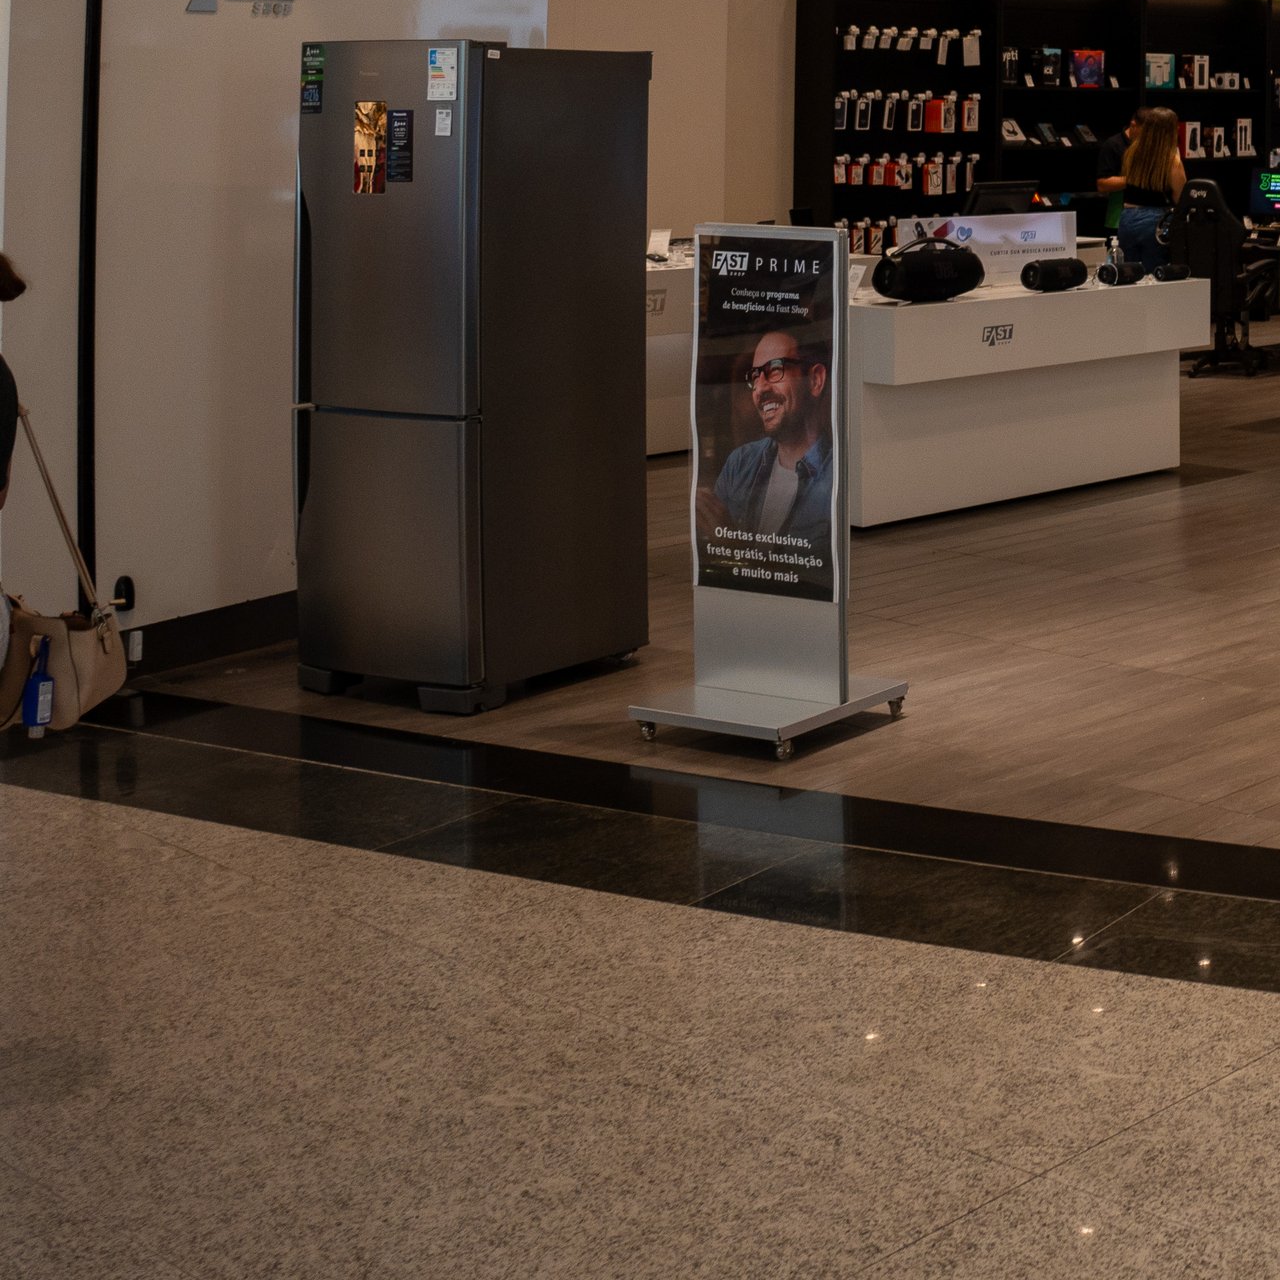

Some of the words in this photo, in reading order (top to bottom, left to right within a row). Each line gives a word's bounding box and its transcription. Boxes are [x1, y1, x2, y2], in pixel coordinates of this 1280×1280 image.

[1003, 50, 1019, 62] yeti
[713, 252, 748, 275] FAST
[755, 258, 820, 274] PRIME
[731, 288, 760, 298] Conheça
[766, 291, 800, 300] programa
[722, 301, 731, 309] de
[731, 301, 765, 312] benefícios
[766, 304, 775, 312] da
[776, 304, 790, 313] Fast
[791, 305, 809, 317] Shop
[983, 325, 1013, 346] FAST
[715, 526, 754, 541] Ofertas
[755, 532, 812, 549] exclusivas,
[706, 543, 732, 557] frete
[733, 548, 767, 562] grátis,
[768, 551, 824, 568] instalação
[732, 567, 739, 575] e
[741, 567, 772, 580] muito
[774, 570, 799, 583] mais
